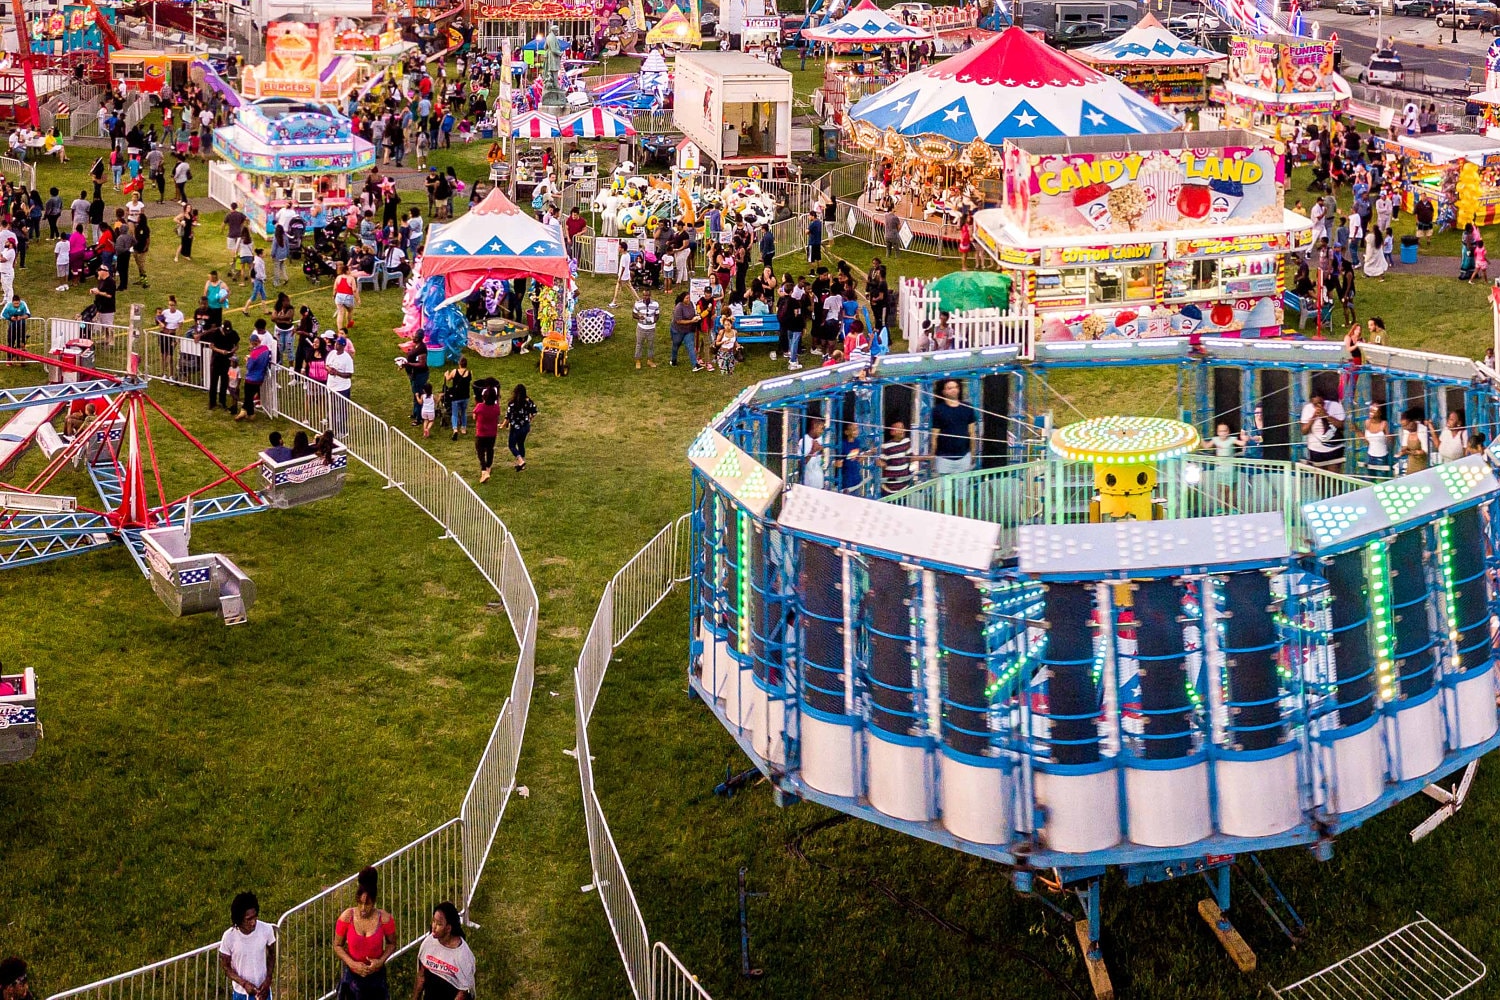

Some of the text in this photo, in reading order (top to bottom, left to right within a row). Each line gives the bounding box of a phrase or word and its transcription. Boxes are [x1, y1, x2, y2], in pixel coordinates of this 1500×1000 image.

[748, 19, 777, 28] TICKETS
[1290, 45, 1327, 56] FUNNEL
[1291, 54, 1324, 65] CAKES
[264, 83, 312, 92] BURGERS
[1039, 156, 1144, 196] CANDY
[1184, 154, 1263, 184] LAND
[1061, 246, 1152, 263] COTTON CANDY
[426, 959, 439, 969] NEW
